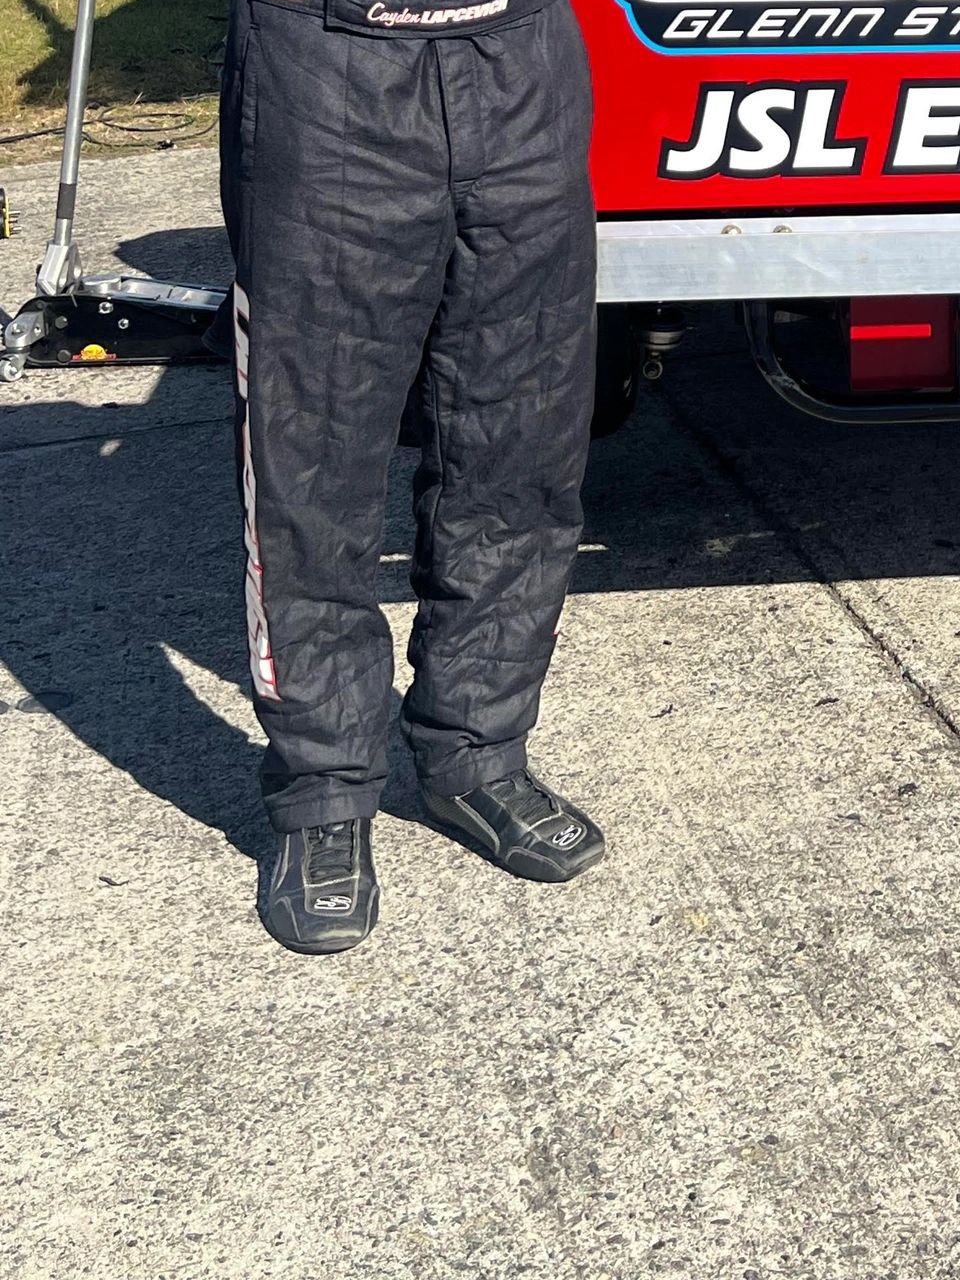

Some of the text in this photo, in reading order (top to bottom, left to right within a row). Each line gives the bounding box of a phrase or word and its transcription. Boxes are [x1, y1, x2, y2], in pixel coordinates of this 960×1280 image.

[366, 1, 421, 27] Cayden
[662, 7, 886, 40] GLENN
[661, 84, 862, 176] JSL
